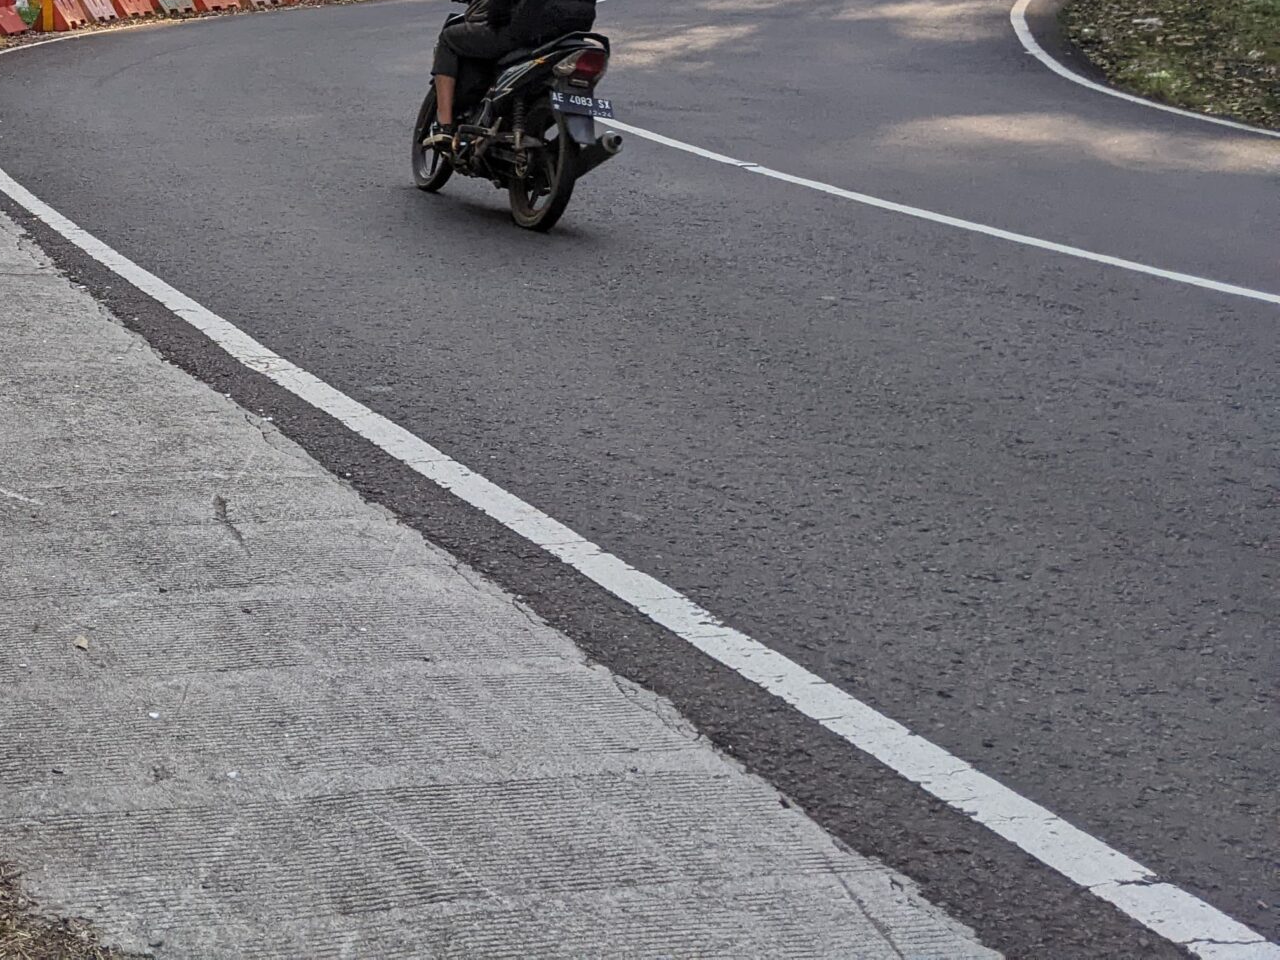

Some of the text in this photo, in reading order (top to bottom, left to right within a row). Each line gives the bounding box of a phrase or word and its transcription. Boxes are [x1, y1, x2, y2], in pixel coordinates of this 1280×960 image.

[552, 92, 611, 109] AE 4083 SX
